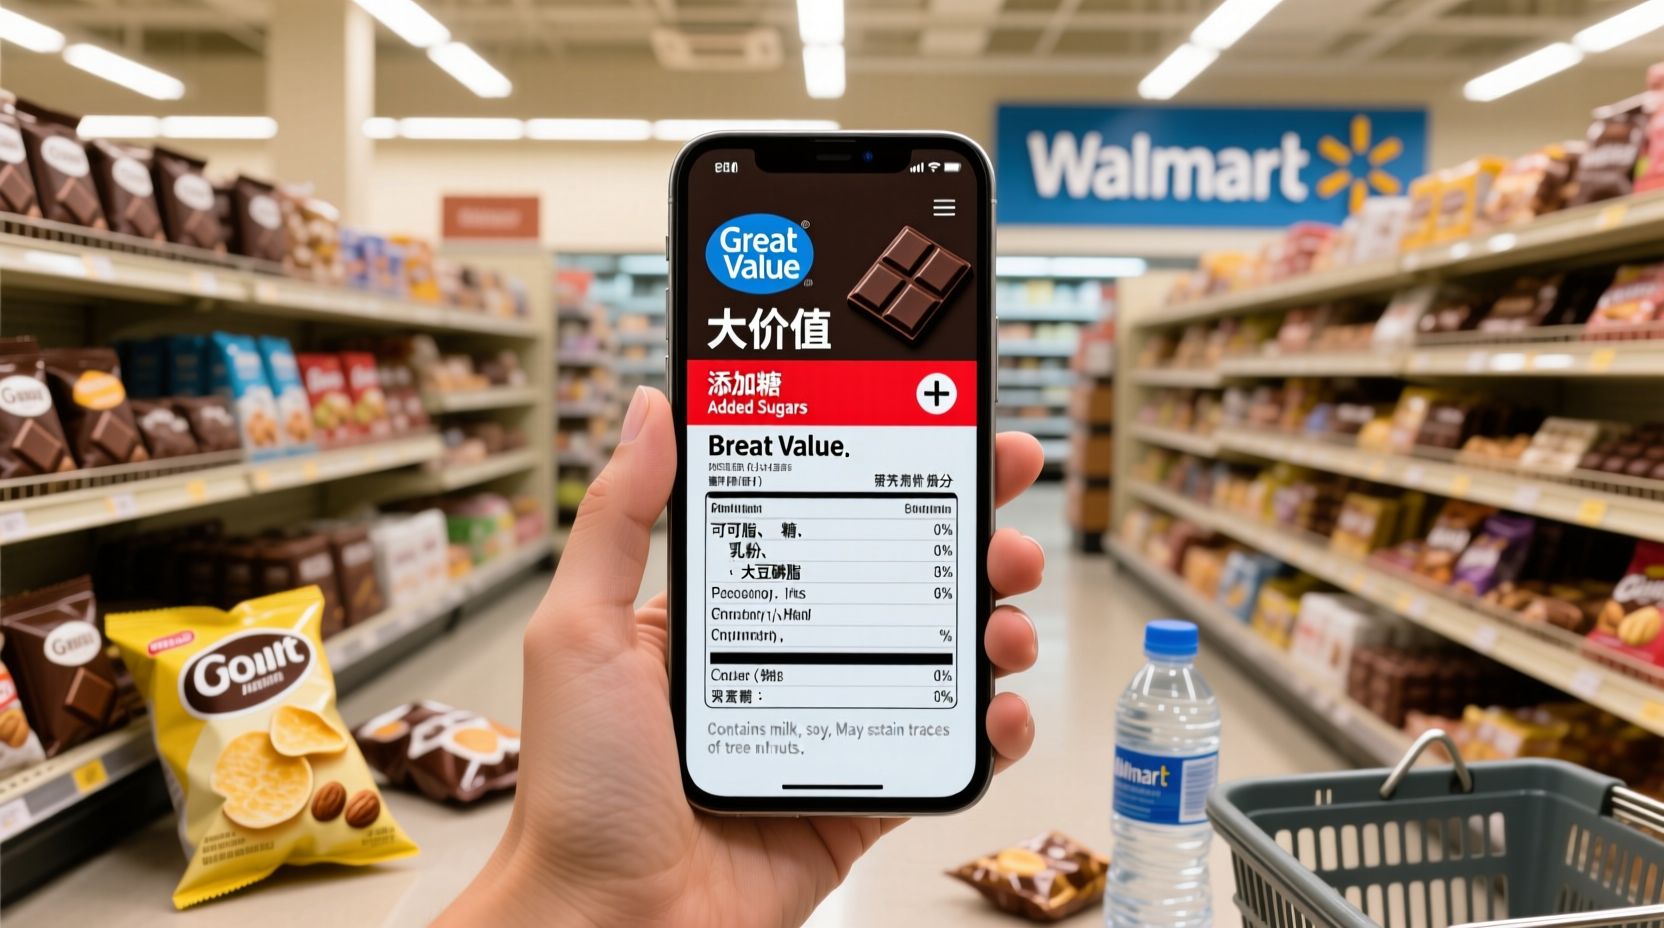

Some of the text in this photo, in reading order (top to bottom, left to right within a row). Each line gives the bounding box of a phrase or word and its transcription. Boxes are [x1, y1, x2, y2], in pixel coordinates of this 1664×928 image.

[1026, 130, 1310, 203] Walmart
[720, 226, 798, 253] Great
[722, 254, 801, 279] Value
[707, 307, 832, 350] 大价值
[707, 370, 782, 397] 添加糖
[707, 398, 808, 418] Added Sugars
[708, 434, 850, 458] Breat Value.
[933, 523, 953, 536] 0%
[933, 544, 953, 557] 0%
[707, 721, 766, 737] Contains
[770, 721, 802, 739] milk,
[835, 721, 864, 740] May
[908, 722, 950, 737] traces
[707, 739, 722, 754] of
[725, 740, 751, 755] tree
